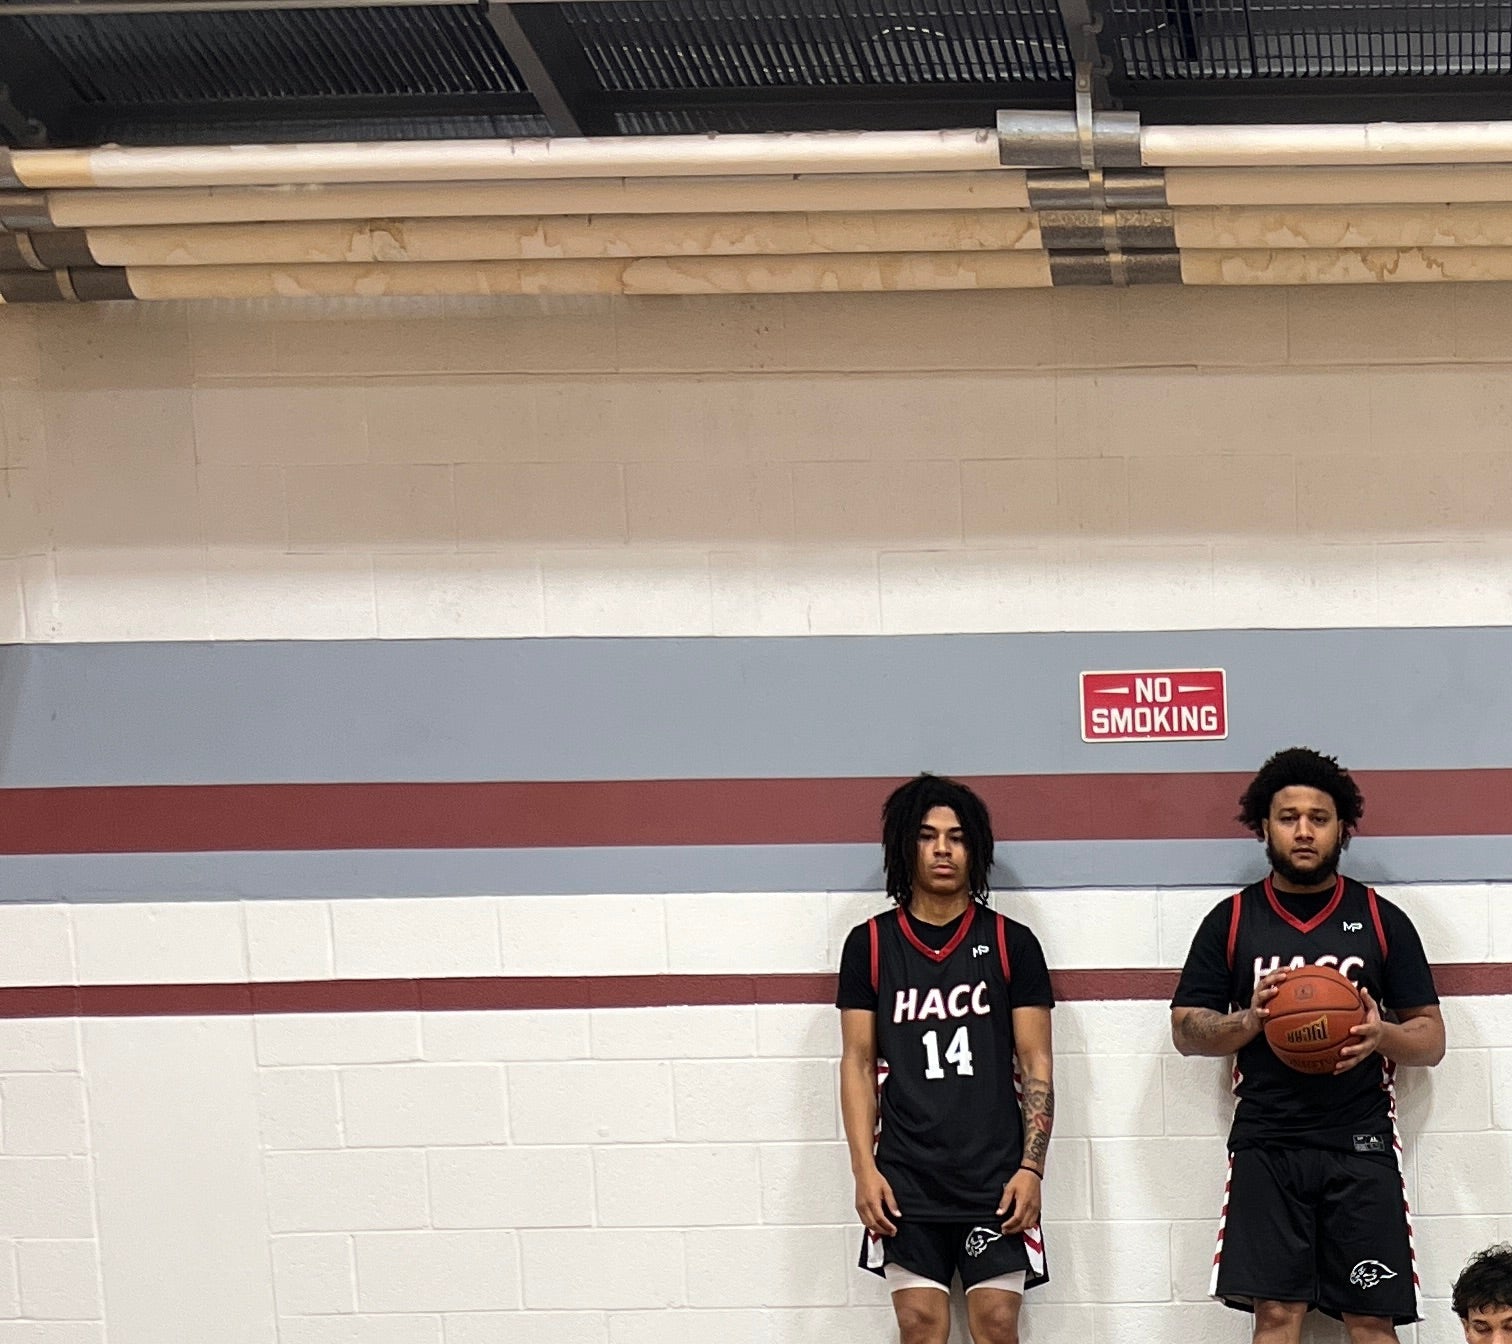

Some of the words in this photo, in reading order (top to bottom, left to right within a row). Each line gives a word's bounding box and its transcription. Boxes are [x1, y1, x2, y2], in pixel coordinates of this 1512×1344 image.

[1135, 677, 1172, 703] NO
[1092, 705, 1218, 733] SMOKING
[893, 981, 991, 1024] HACC
[922, 1025, 974, 1079] 14
